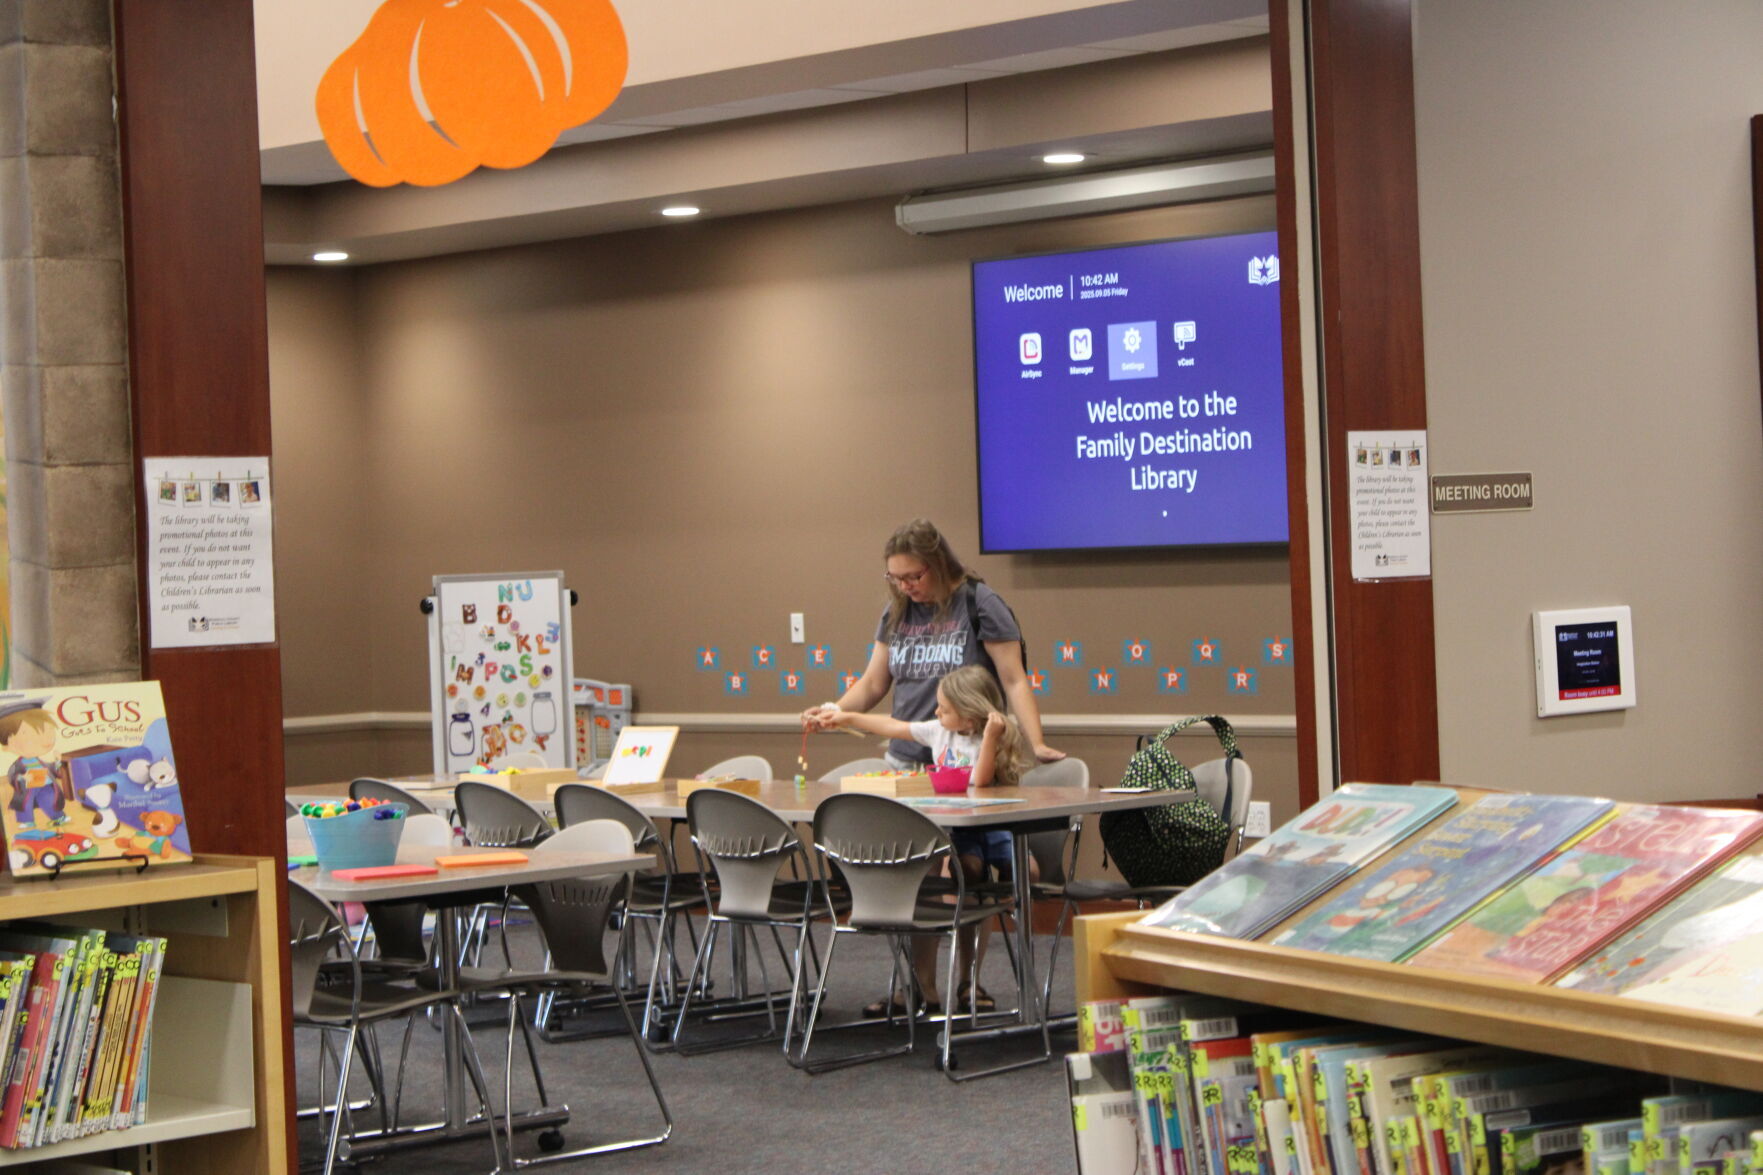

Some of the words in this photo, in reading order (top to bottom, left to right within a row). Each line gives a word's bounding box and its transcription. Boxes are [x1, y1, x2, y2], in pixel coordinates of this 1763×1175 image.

[1080, 274, 1103, 287] 10:42
[1104, 273, 1119, 285] AM
[1004, 283, 1063, 303] Welcome
[1111, 287, 1128, 298] Friday
[1087, 397, 1174, 424] Welcome
[1178, 396, 1200, 418] to
[1204, 391, 1238, 416] the
[1077, 431, 1136, 461] Family
[1140, 427, 1252, 455] Destination
[1131, 465, 1197, 493] Library
[1436, 485, 1491, 501] MEETING
[1494, 484, 1530, 499] ROOM
[161, 515, 172, 525] The
[174, 514, 199, 527] library
[201, 514, 215, 524] will
[217, 514, 225, 524] be
[226, 514, 250, 525] taking
[159, 529, 204, 542] promotional
[204, 528, 229, 542] photos
[230, 529, 239, 538] at
[240, 528, 254, 537] this
[184, 544, 192, 556] If
[192, 546, 206, 556] you
[207, 543, 217, 553] do
[218, 544, 231, 552] not
[232, 544, 251, 552] want
[159, 560, 176, 571] your
[178, 558, 197, 568] child
[197, 559, 205, 567] to
[206, 559, 232, 569] appear
[232, 558, 240, 566] in
[240, 558, 255, 568] any
[188, 572, 210, 584] please
[211, 572, 238, 581] contact
[240, 571, 252, 580] the
[199, 585, 234, 596] Librarian
[161, 604, 170, 612] as
[759, 650, 768, 663] C
[815, 650, 824, 663] E
[912, 644, 964, 665] DOING
[1063, 646, 1074, 659] M
[1132, 646, 1143, 658] O
[1200, 645, 1212, 658] Q
[1273, 644, 1283, 657] S
[519, 654, 534, 676] S
[732, 676, 741, 689] B
[788, 676, 797, 688] D
[1032, 675, 1041, 688] L
[1098, 674, 1109, 688] N
[1168, 674, 1178, 686] P
[1237, 674, 1248, 686] R
[56, 696, 141, 727] GUS
